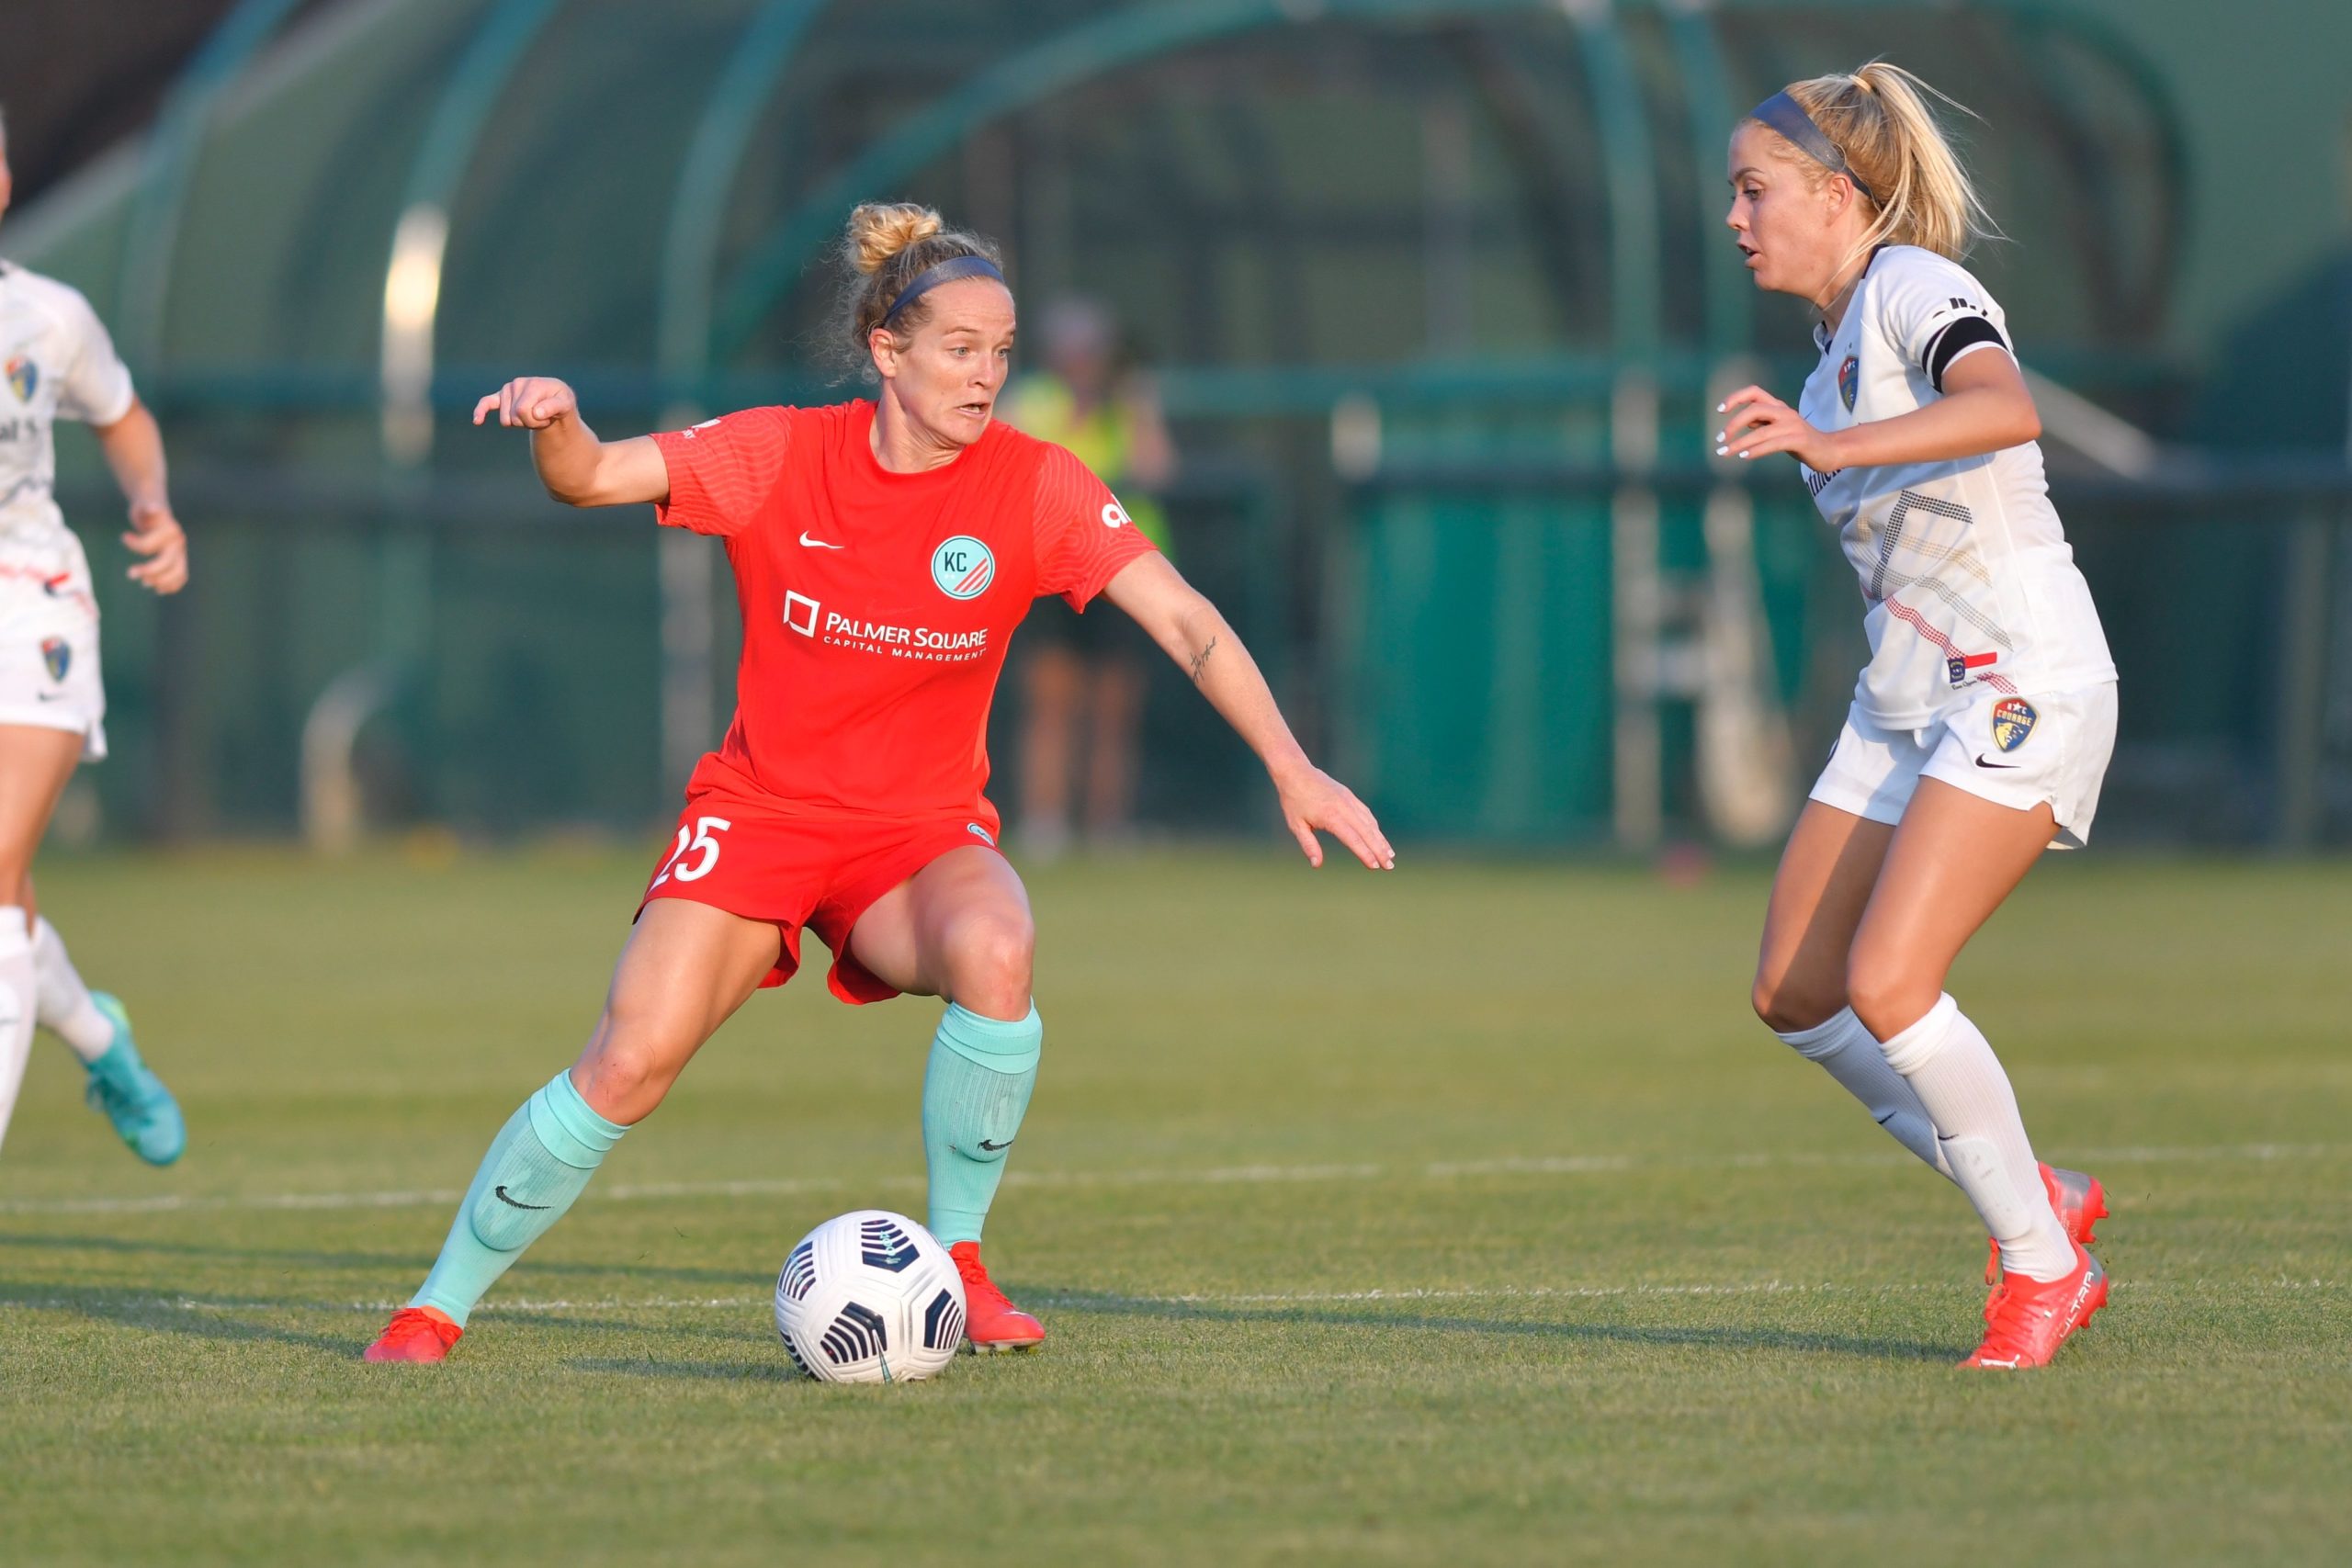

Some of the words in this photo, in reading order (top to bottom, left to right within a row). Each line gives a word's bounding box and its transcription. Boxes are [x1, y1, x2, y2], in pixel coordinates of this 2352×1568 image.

[944, 551, 967, 572] KC
[823, 636, 883, 654] CAPITAL
[891, 648, 985, 661] MANAGEMENT
[825, 612, 910, 644] PALMER
[913, 628, 989, 649] SQUARE
[646, 817, 731, 897] 25
[2059, 1271, 2094, 1338] ULTRA
